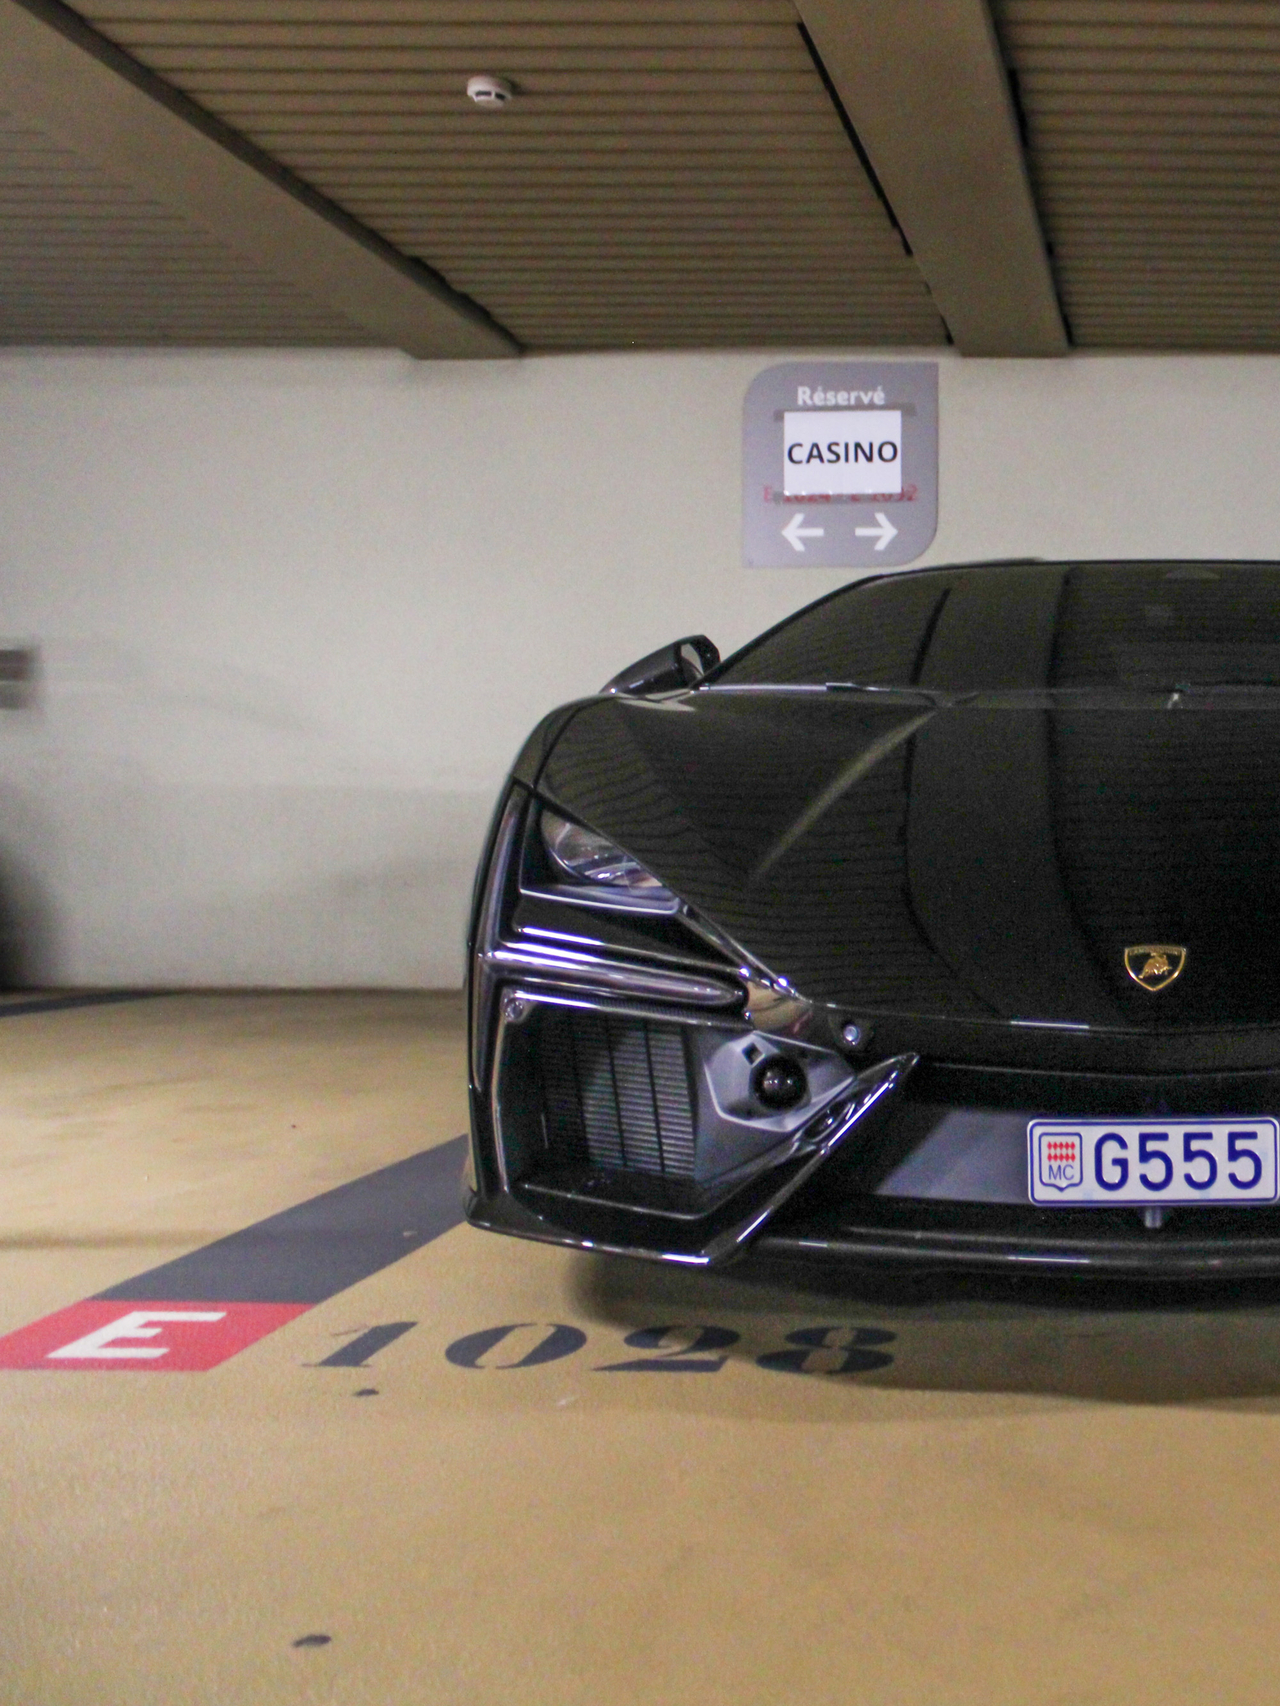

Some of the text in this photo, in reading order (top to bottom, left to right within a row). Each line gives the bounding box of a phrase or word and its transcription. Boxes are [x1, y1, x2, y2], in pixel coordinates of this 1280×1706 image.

[797, 385, 886, 407] Réservé
[787, 440, 898, 465] CASINO
[1048, 1164, 1075, 1181] MC
[1094, 1131, 1263, 1192] G555
[45, 1310, 227, 1360] E
[300, 1321, 896, 1374] 1028
